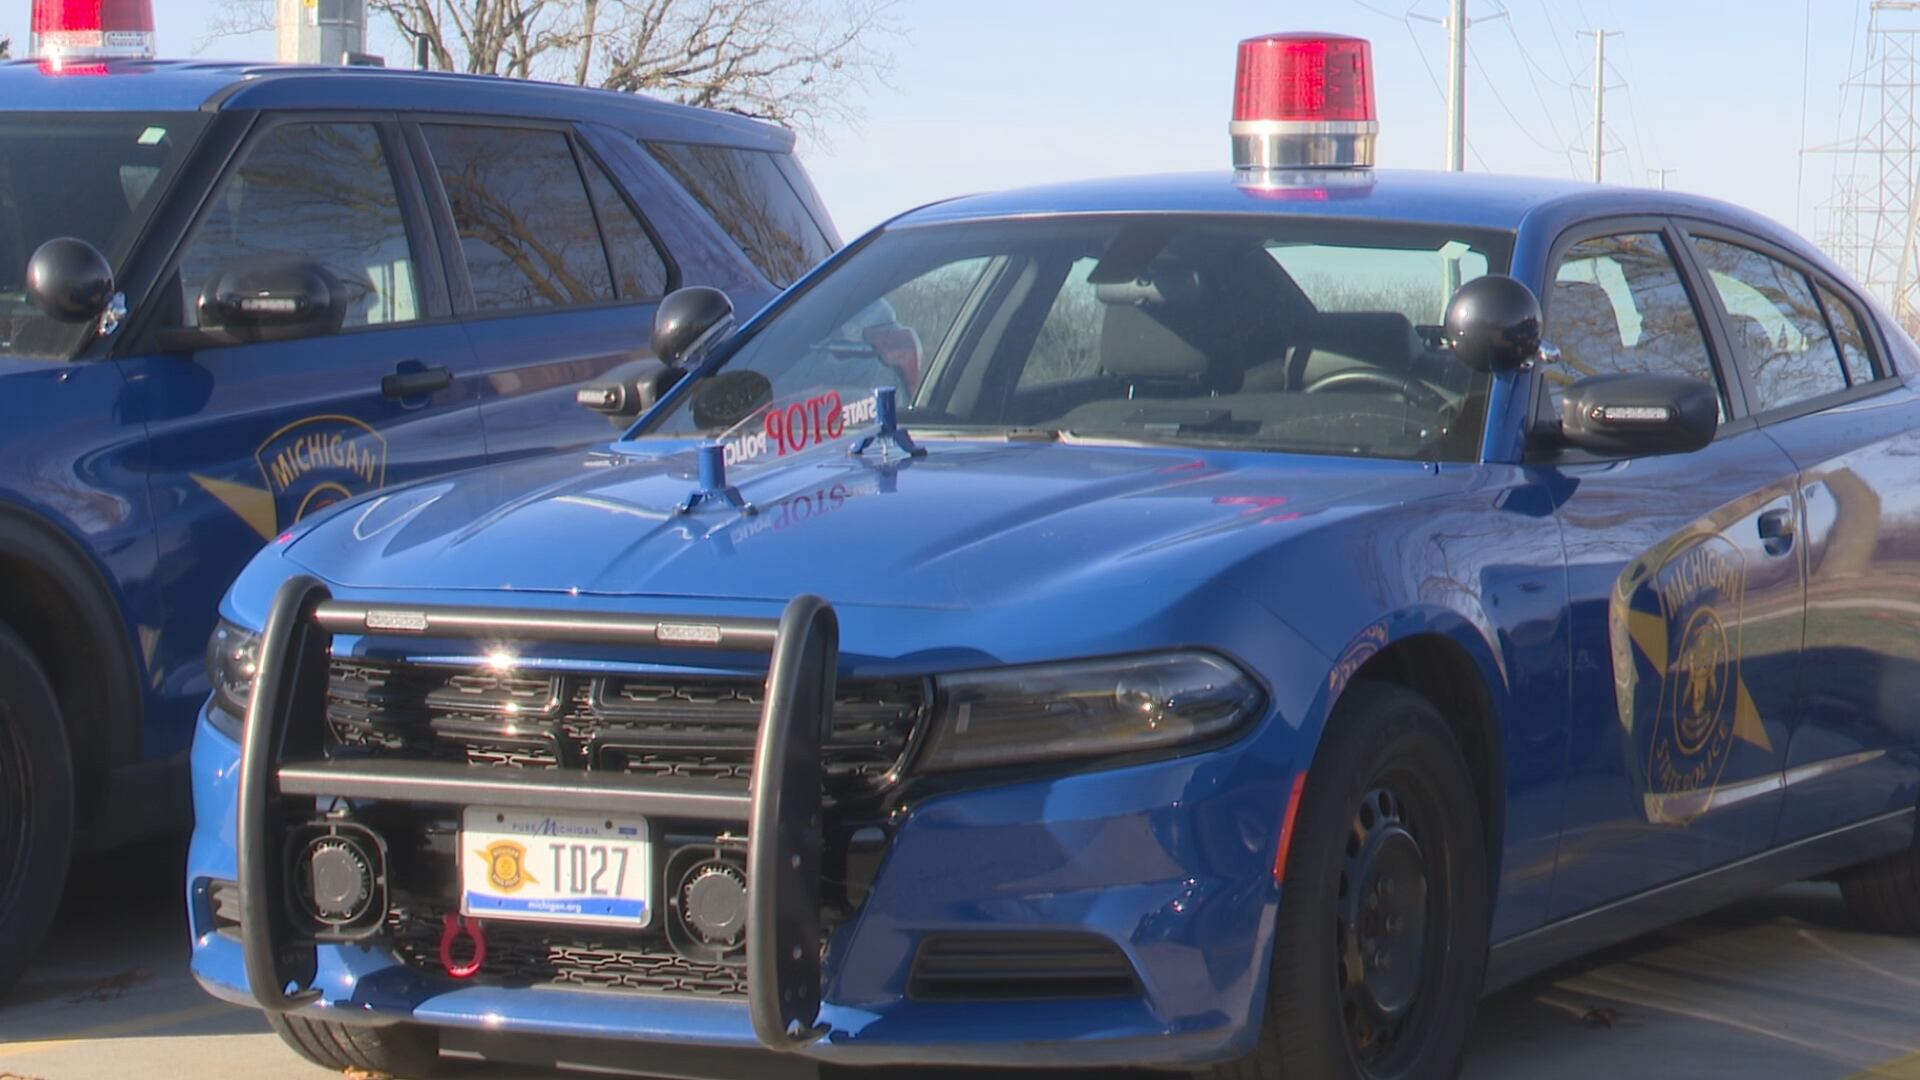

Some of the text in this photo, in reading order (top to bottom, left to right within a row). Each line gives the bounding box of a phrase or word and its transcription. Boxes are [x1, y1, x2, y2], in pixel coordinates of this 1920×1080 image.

[270, 431, 376, 493] MICHIGAN
[1663, 549, 1738, 620] MICHIGAN
[511, 822, 536, 833] PURE
[549, 844, 629, 897] TD27
[527, 899, 582, 914] michigan.org
